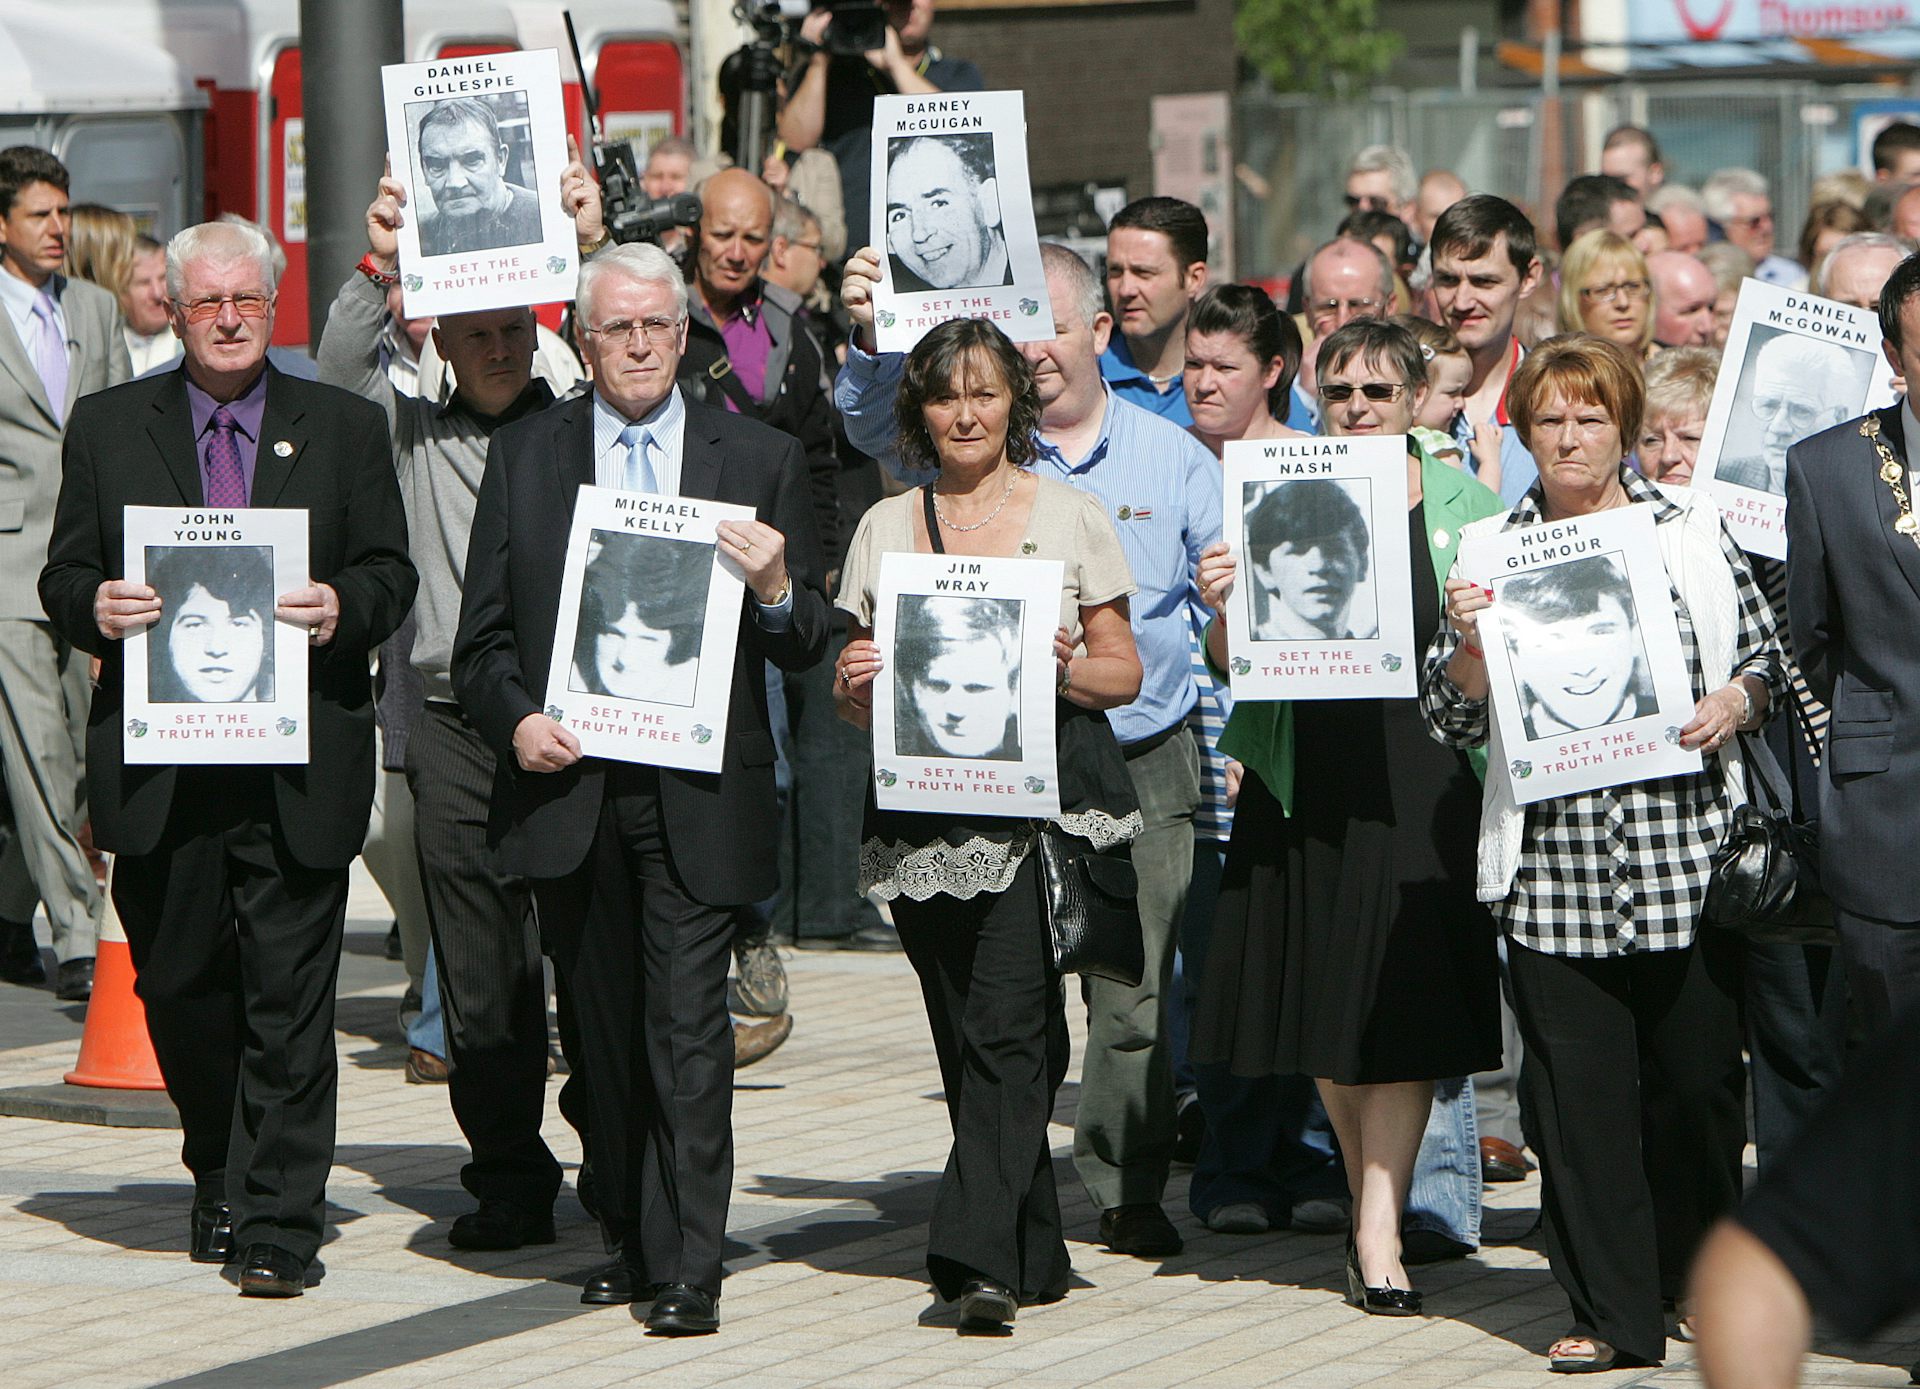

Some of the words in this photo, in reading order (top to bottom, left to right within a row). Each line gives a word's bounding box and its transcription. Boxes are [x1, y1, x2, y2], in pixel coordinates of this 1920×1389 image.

[427, 61, 497, 79] DANIEL
[413, 75, 515, 97] GILLESPIE
[907, 100, 970, 114] BARNEY
[896, 116, 982, 132] McGUIGAN
[448, 263, 480, 275] SET
[488, 256, 520, 269] THE
[432, 275, 489, 291] TRUTH
[497, 268, 539, 283] FREE
[922, 300, 952, 312] SET
[961, 297, 992, 308] THE
[1786, 297, 1857, 325] DANIEL
[970, 309, 1012, 321] FREE
[1768, 310, 1867, 344] McGOWAN
[1263, 444, 1349, 458] WILLIAM
[1280, 462, 1333, 475] NASH
[615, 498, 701, 519] MICHAEL
[1735, 497, 1767, 513] SET
[181, 514, 235, 525] JOHN
[624, 516, 685, 534] KELLY
[174, 530, 243, 541] YOUNG
[1520, 524, 1579, 547] HUGH
[1506, 537, 1602, 569] GILMOUR
[947, 563, 982, 575] JIM
[935, 579, 990, 592] WRAY
[1279, 651, 1311, 662] SET
[1320, 650, 1354, 661] THE
[1261, 666, 1320, 677] TRUTH
[1329, 664, 1373, 675] FREE
[175, 714, 207, 725] SET
[216, 713, 250, 724] THE
[590, 706, 623, 720] SET
[631, 711, 666, 726] THE
[157, 729, 215, 740] TRUTH
[224, 728, 268, 739] FREE
[571, 718, 628, 736] TRUTH
[637, 728, 682, 743] FREE
[1559, 740, 1592, 757] SET
[1600, 730, 1637, 748] THE
[1543, 753, 1604, 775] TRUTH
[1612, 741, 1658, 761] FREE
[923, 767, 955, 778] SET
[963, 769, 998, 781] THE
[906, 780, 965, 793] TRUTH
[973, 785, 1017, 795] FREE
